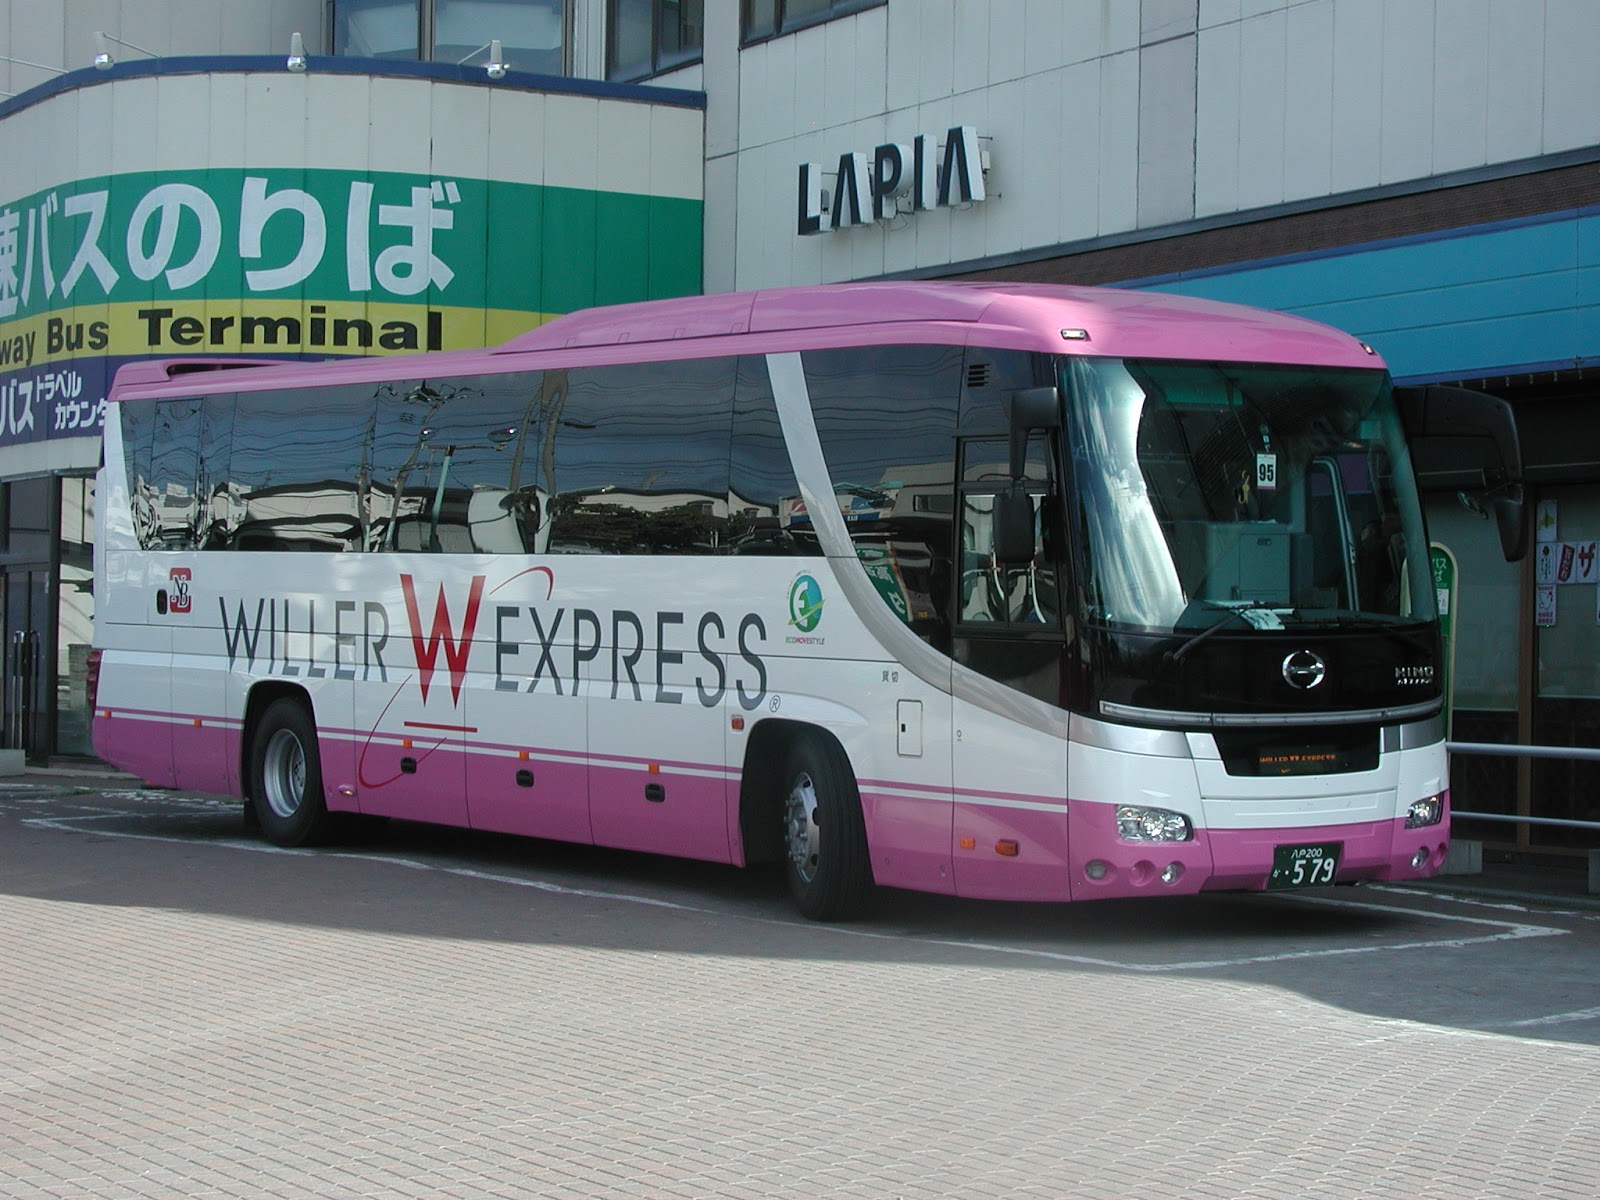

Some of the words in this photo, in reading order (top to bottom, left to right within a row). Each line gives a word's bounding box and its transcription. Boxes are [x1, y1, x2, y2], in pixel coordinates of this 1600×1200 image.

[798, 125, 983, 235] LAPIA
[47, 317, 109, 354] Bus
[138, 305, 442, 351] Terminal
[36, 369, 82, 403] トラベル
[1259, 463, 1274, 482] 95
[219, 596, 390, 683] WILLER
[400, 573, 487, 709] W
[495, 606, 767, 711] EXPRESS
[1395, 666, 1434, 678] HINO
